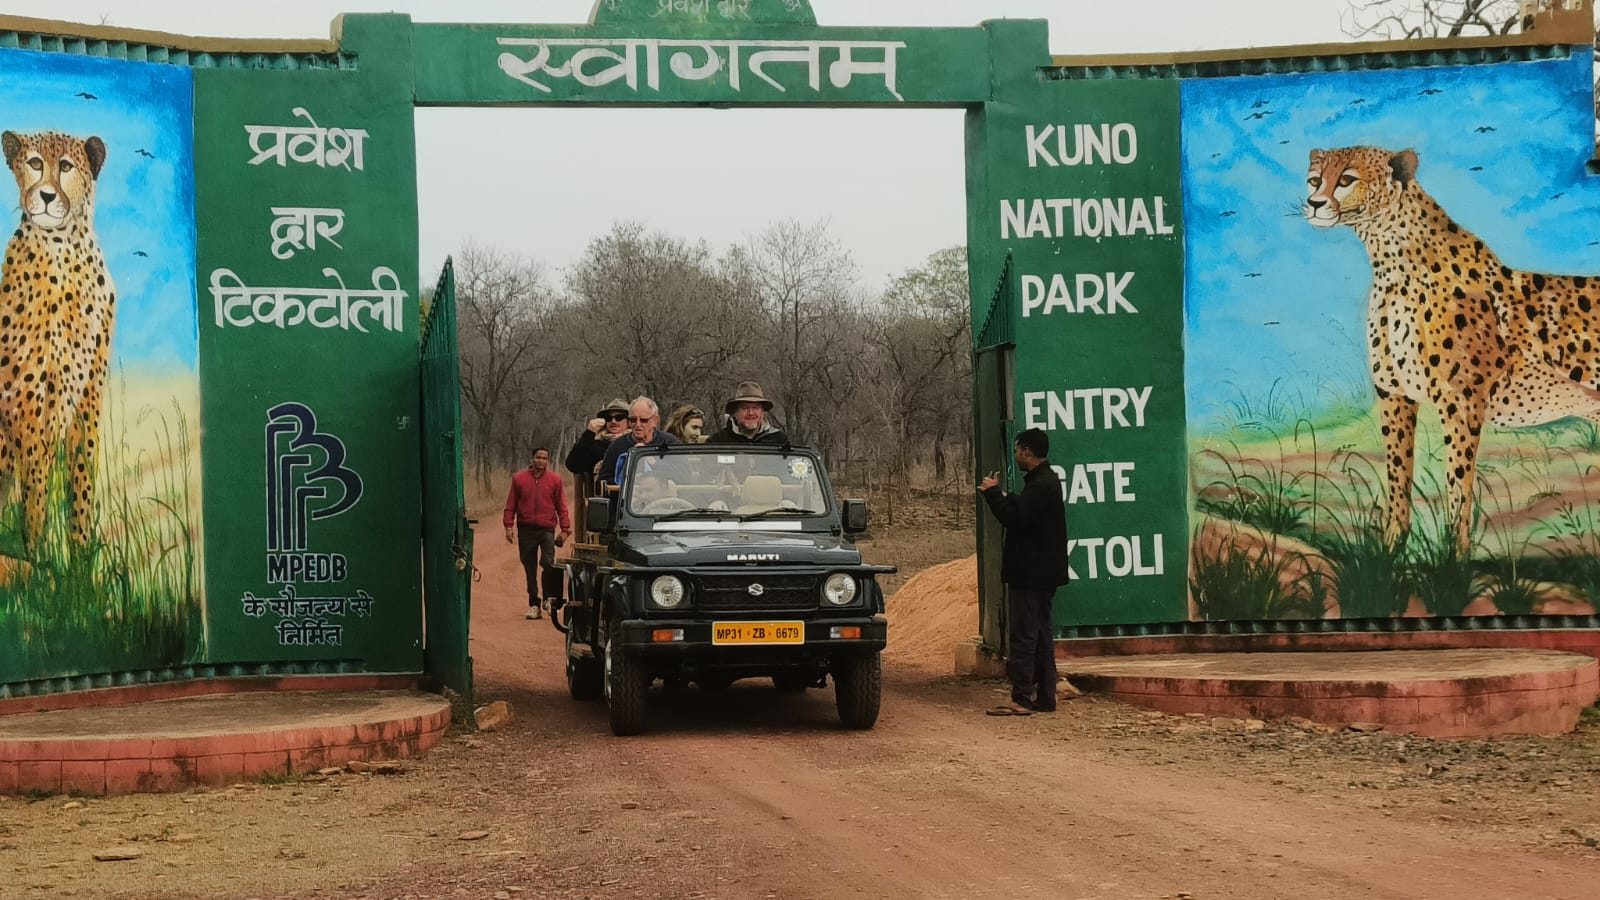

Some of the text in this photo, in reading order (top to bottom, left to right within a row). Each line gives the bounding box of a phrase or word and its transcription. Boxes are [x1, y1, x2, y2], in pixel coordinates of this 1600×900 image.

[244, 107, 370, 172] प्रवेश
[1025, 123, 1137, 167] KUNO
[271, 207, 345, 260] द्वार
[1000, 196, 1174, 239] NATIONAL
[208, 266, 408, 333] टिकटोली
[1021, 272, 1139, 317] PARK
[1024, 386, 1153, 430] ENTRY
[267, 553, 347, 584] MPEDB
[727, 553, 780, 561] MARUTI
[716, 627, 799, 640] MP31 ZB 6679
